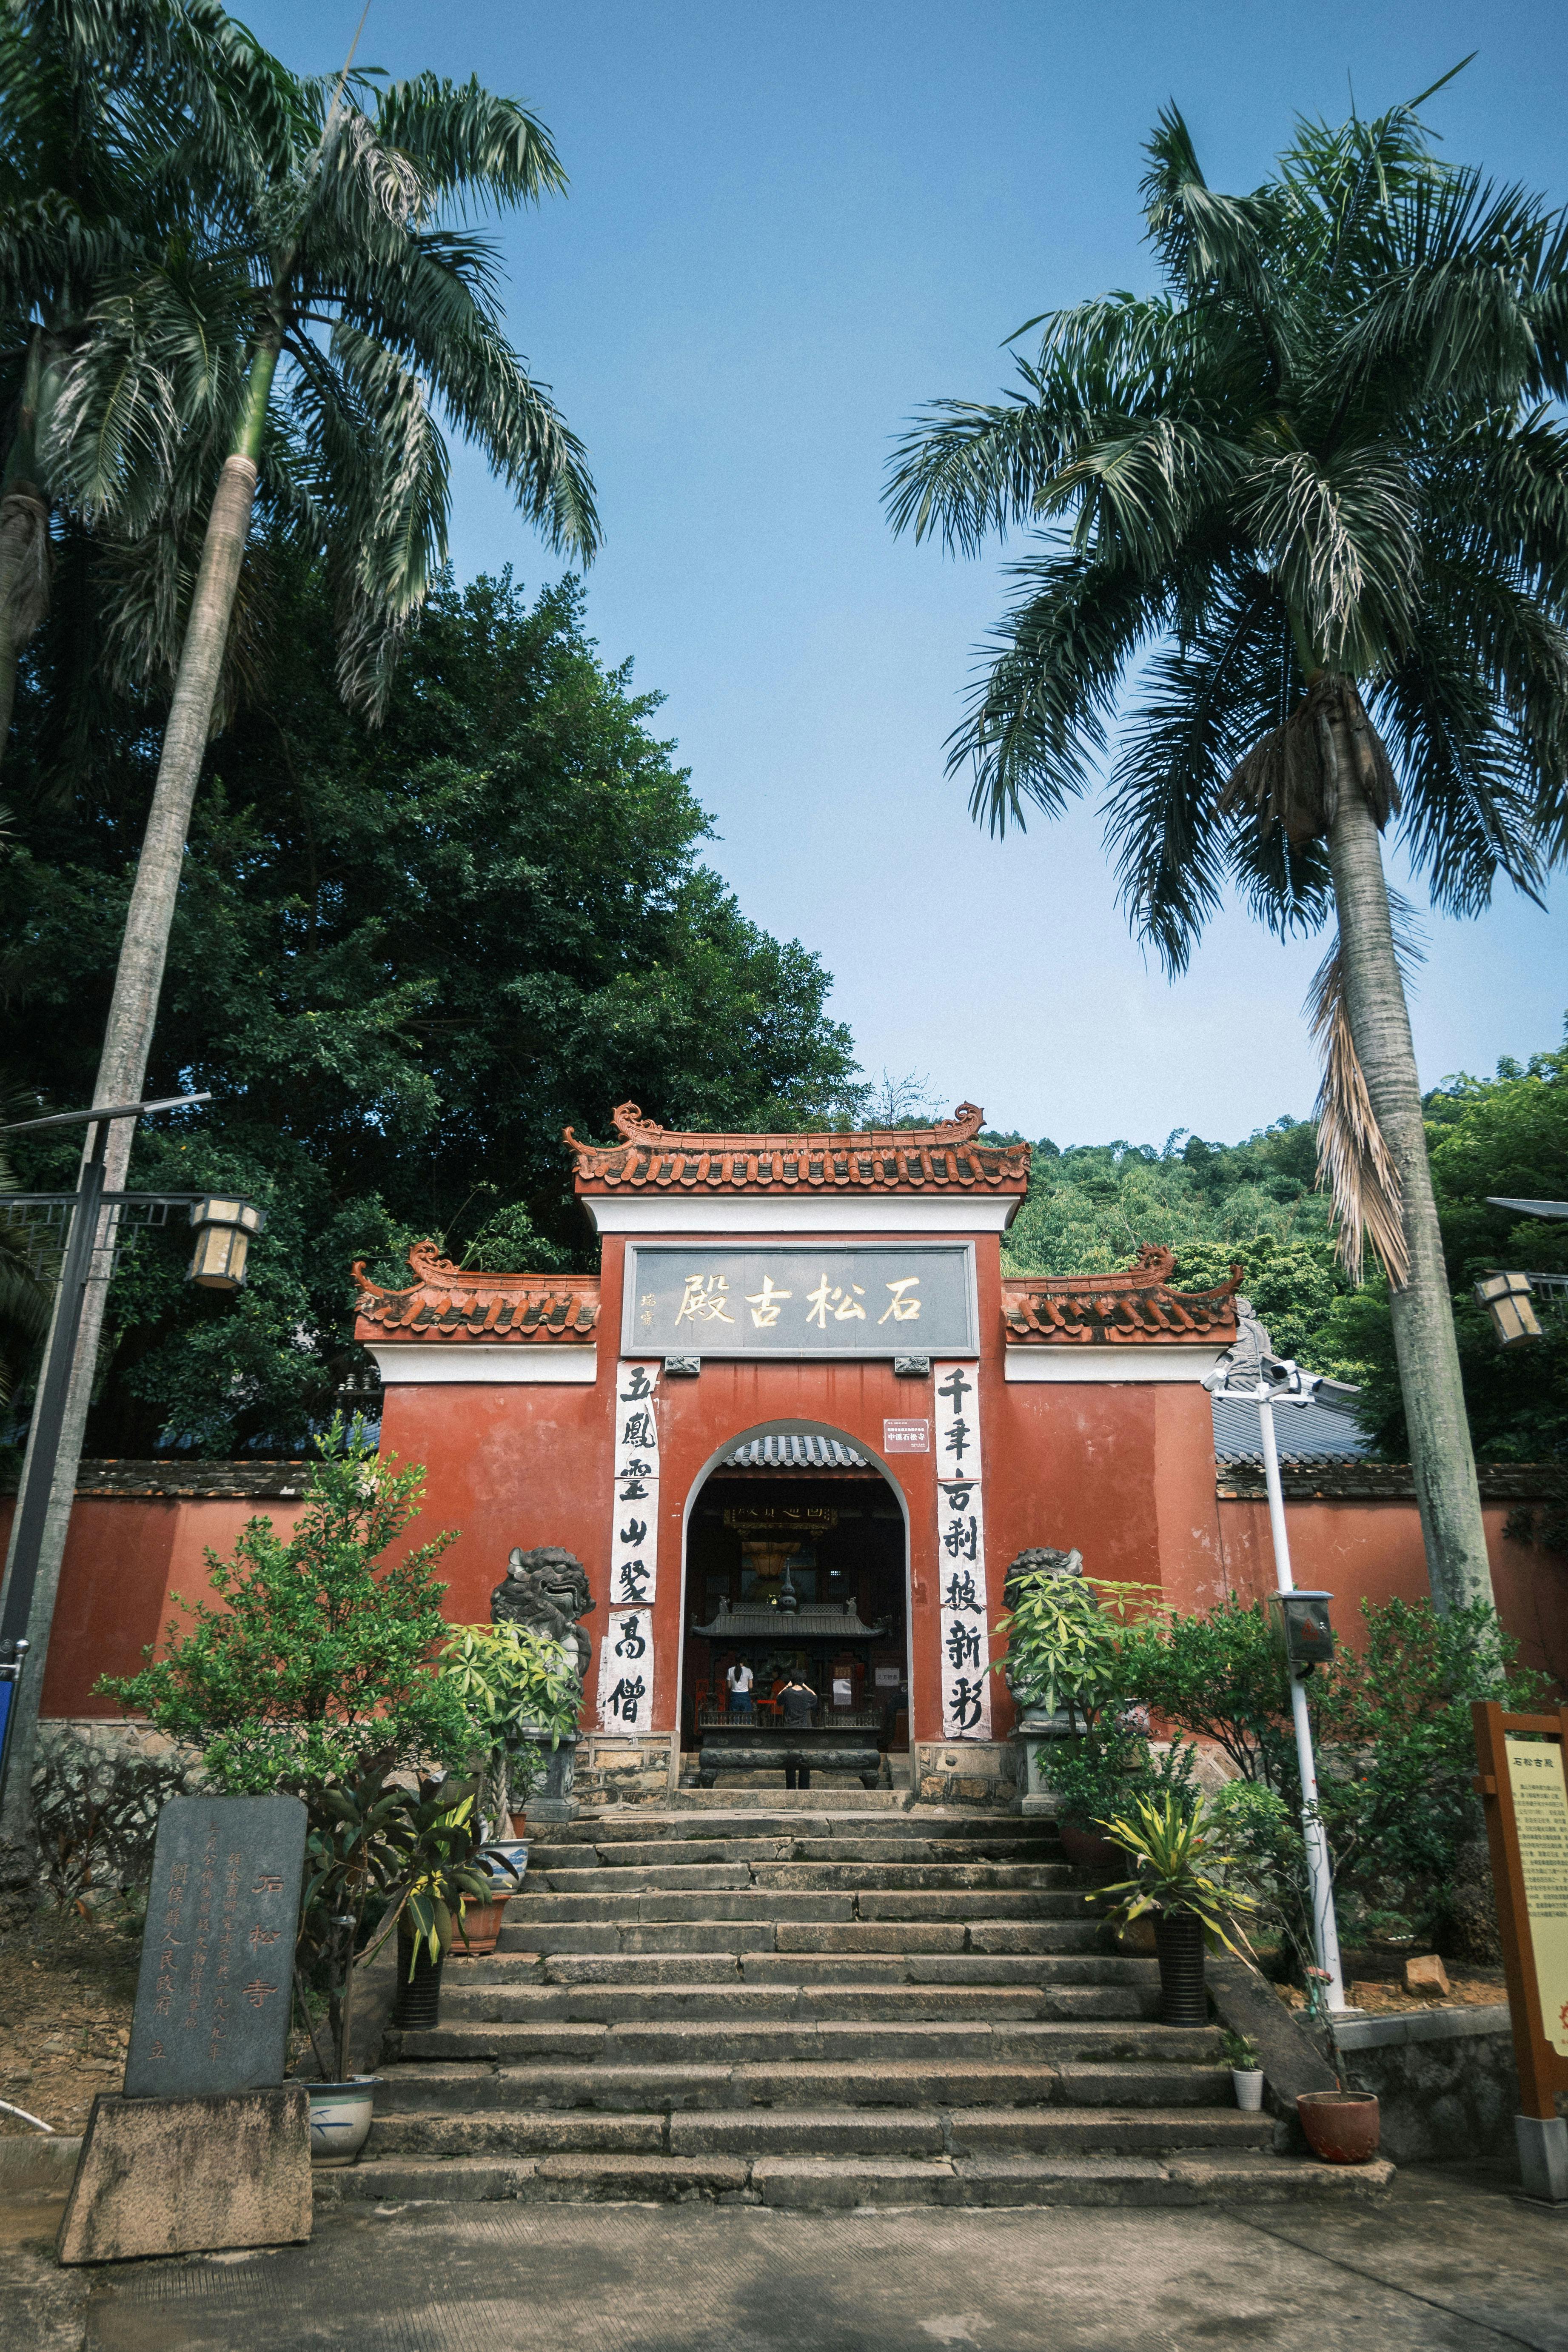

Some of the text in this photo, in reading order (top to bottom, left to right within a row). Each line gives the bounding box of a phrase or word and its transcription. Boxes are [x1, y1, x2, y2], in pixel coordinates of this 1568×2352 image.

[674, 1272, 921, 1329] 石松古殿
[1513, 1757, 1554, 1768] 石松古殿
[242, 1874, 285, 2008] 石松寺
[147, 2040, 166, 2060] 立
